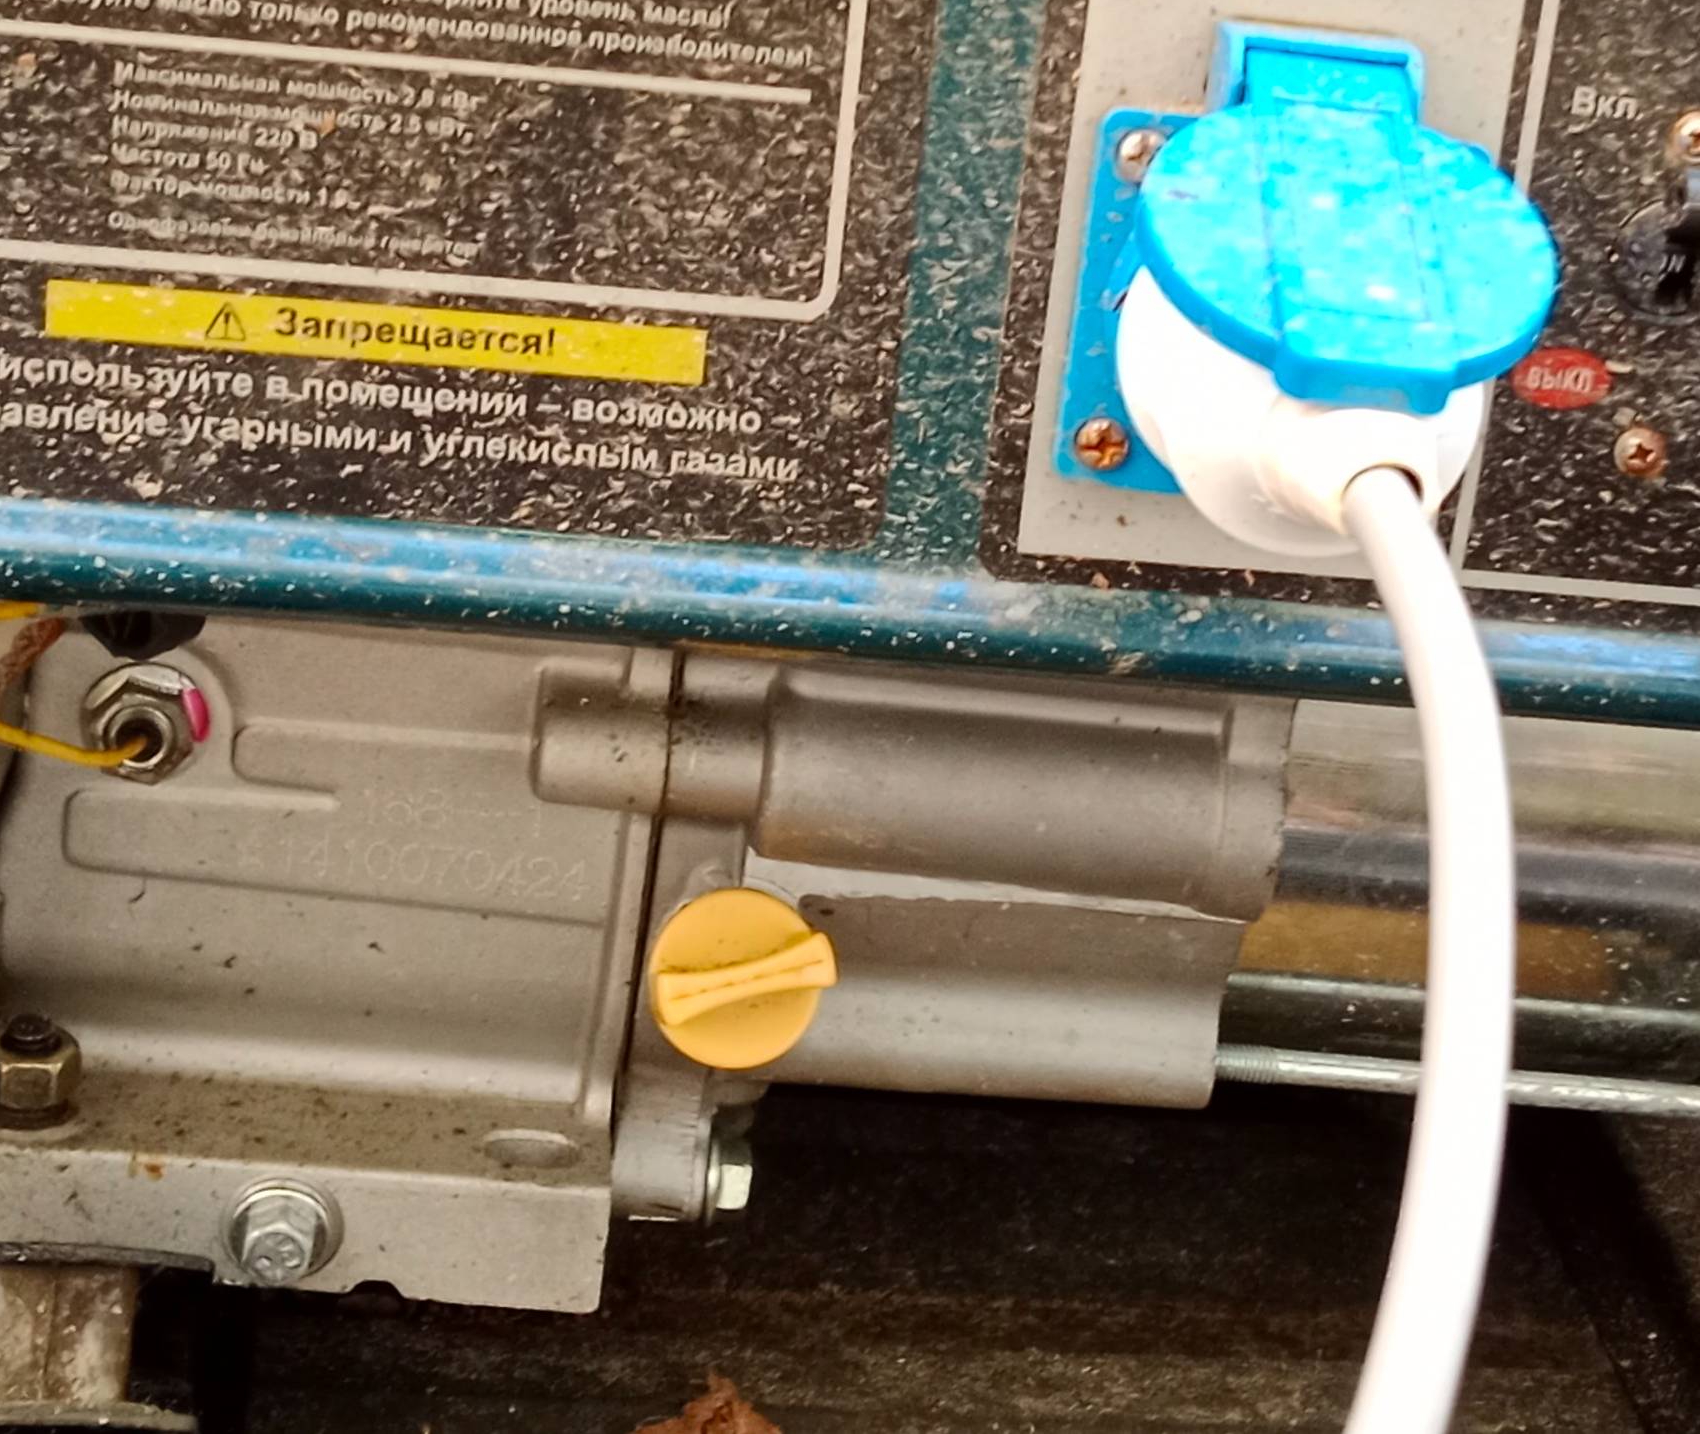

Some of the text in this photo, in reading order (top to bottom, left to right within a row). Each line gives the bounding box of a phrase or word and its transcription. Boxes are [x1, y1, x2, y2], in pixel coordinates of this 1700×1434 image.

[254, 127, 295, 149] 220
[274, 306, 556, 357] Запрещается!
[265, 374, 290, 399] в
[301, 377, 528, 418] помещении
[572, 397, 763, 435] возможно
[179, 412, 380, 454] угарными
[388, 428, 411, 453] и
[421, 427, 659, 472] углекислым
[669, 448, 801, 483] газами
